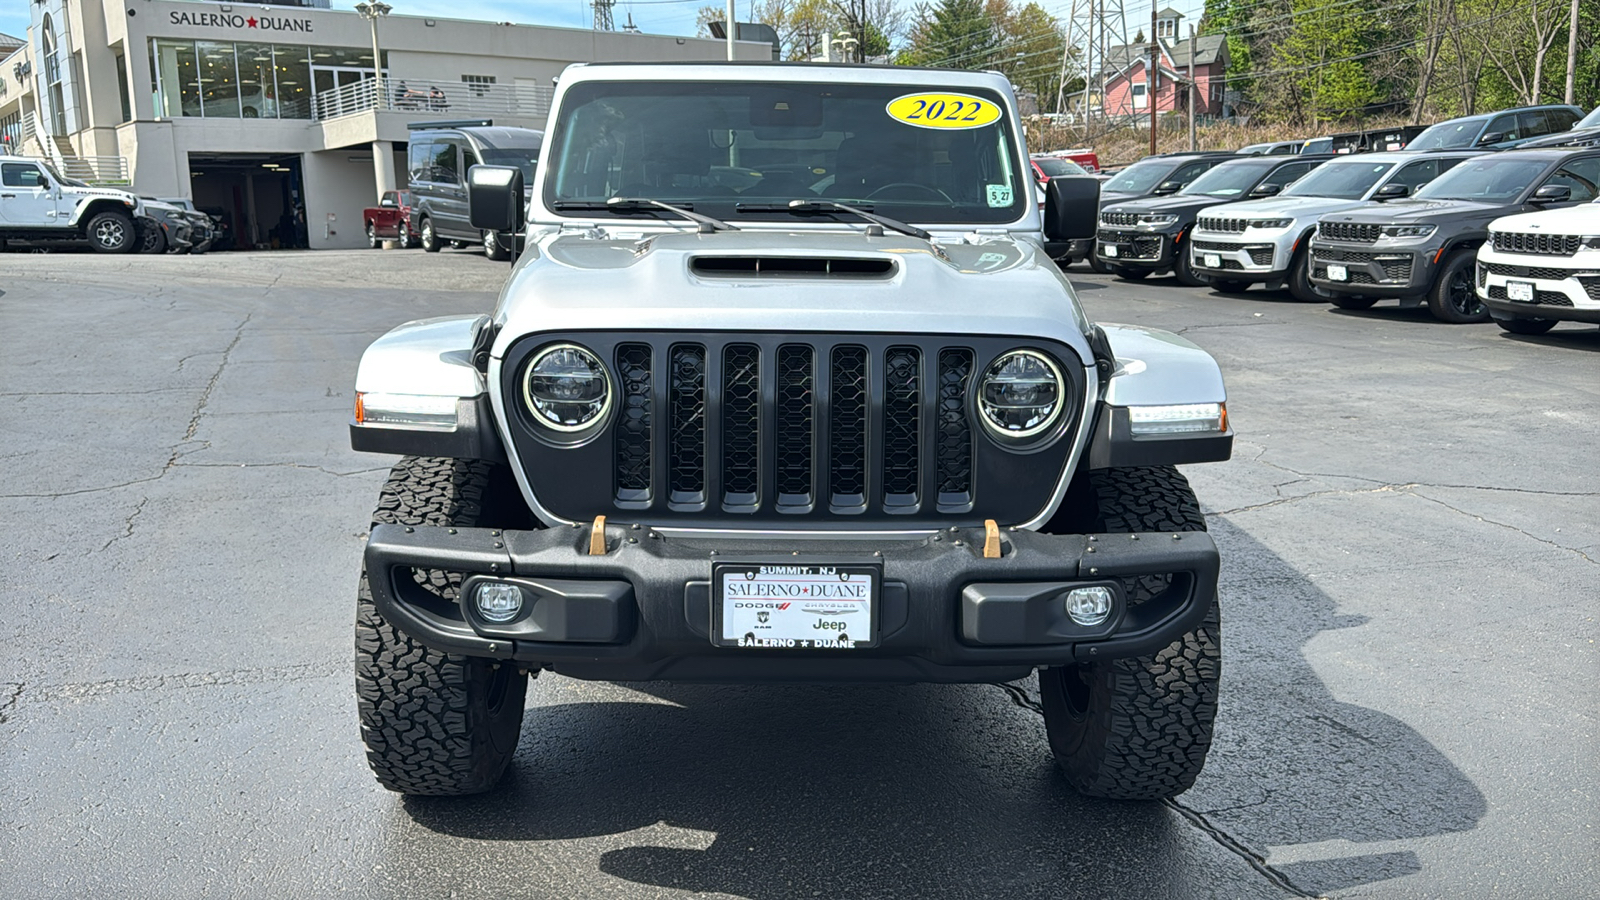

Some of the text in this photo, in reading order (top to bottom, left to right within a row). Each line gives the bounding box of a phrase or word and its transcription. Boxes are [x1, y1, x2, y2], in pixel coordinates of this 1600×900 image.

[170, 12, 313, 32] SALERNO DUANE
[906, 101, 981, 121] 2022
[992, 191, 1009, 200] 5 27
[820, 567, 836, 575] NJ
[728, 583, 866, 598] SALERNO DUANE
[813, 619, 846, 632] Jeep
[738, 639, 855, 648] SALERNO DUANE
